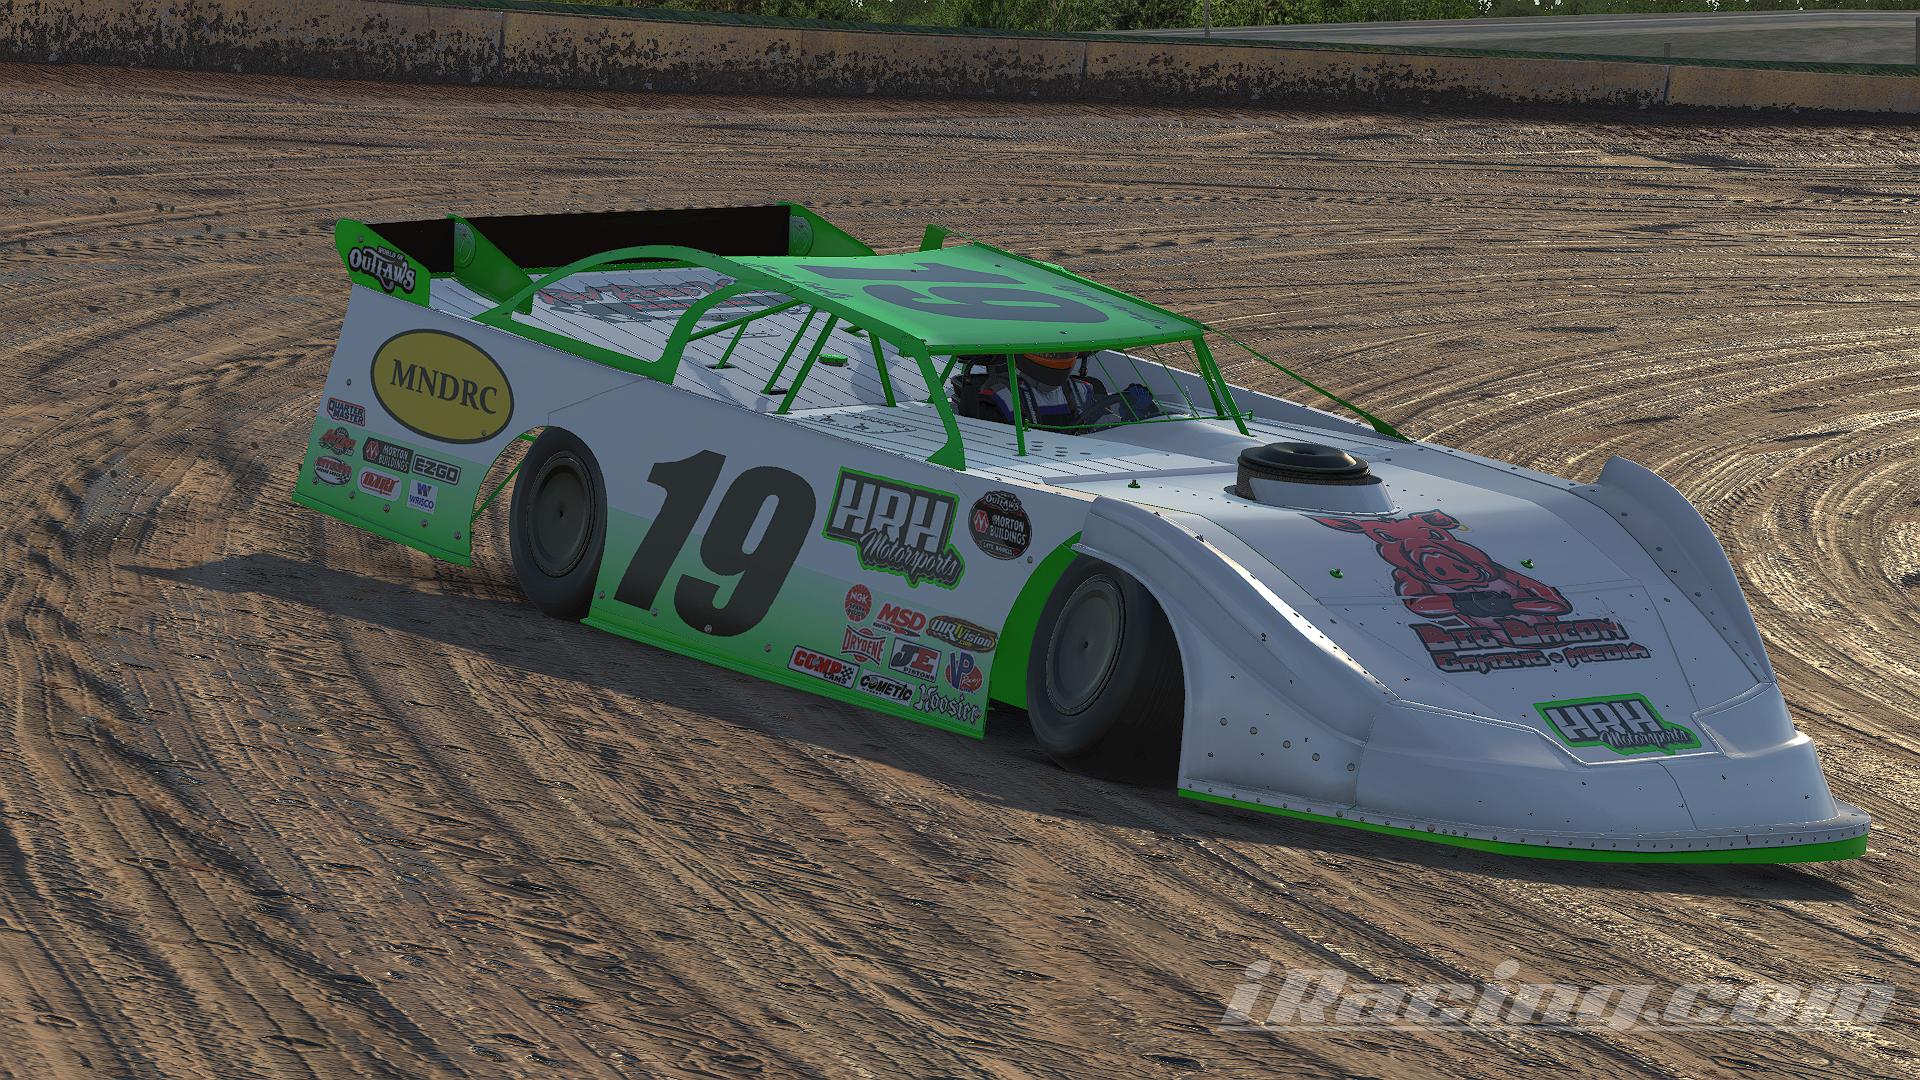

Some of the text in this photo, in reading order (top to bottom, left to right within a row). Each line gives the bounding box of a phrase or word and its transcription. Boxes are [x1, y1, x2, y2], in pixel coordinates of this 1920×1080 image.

[793, 262, 1110, 323] 19
[390, 358, 498, 415] MNDRC
[329, 400, 364, 415] QUARTER
[333, 410, 364, 424] MASTER
[379, 455, 410, 472] BUILDINGS
[383, 445, 409, 459] MORTON
[409, 495, 434, 509] WRISCO
[831, 478, 949, 553] HRH
[993, 515, 1024, 532] MORTON
[613, 449, 816, 636] 19
[990, 525, 1026, 545] BUILDINGS
[860, 528, 958, 576] Motorsports
[850, 592, 868, 604] NGK
[877, 603, 926, 631] MSD
[842, 628, 885, 663] DRYDENE
[793, 650, 842, 674] COMP
[890, 644, 939, 673] JE
[950, 651, 975, 689] VP
[823, 672, 847, 685] CAMS
[903, 666, 935, 680] PISTONS
[860, 675, 913, 701] COMETIC
[913, 683, 981, 725] Hoosier
[1545, 700, 1663, 740] HRH
[1600, 727, 1689, 749] Motorsports
